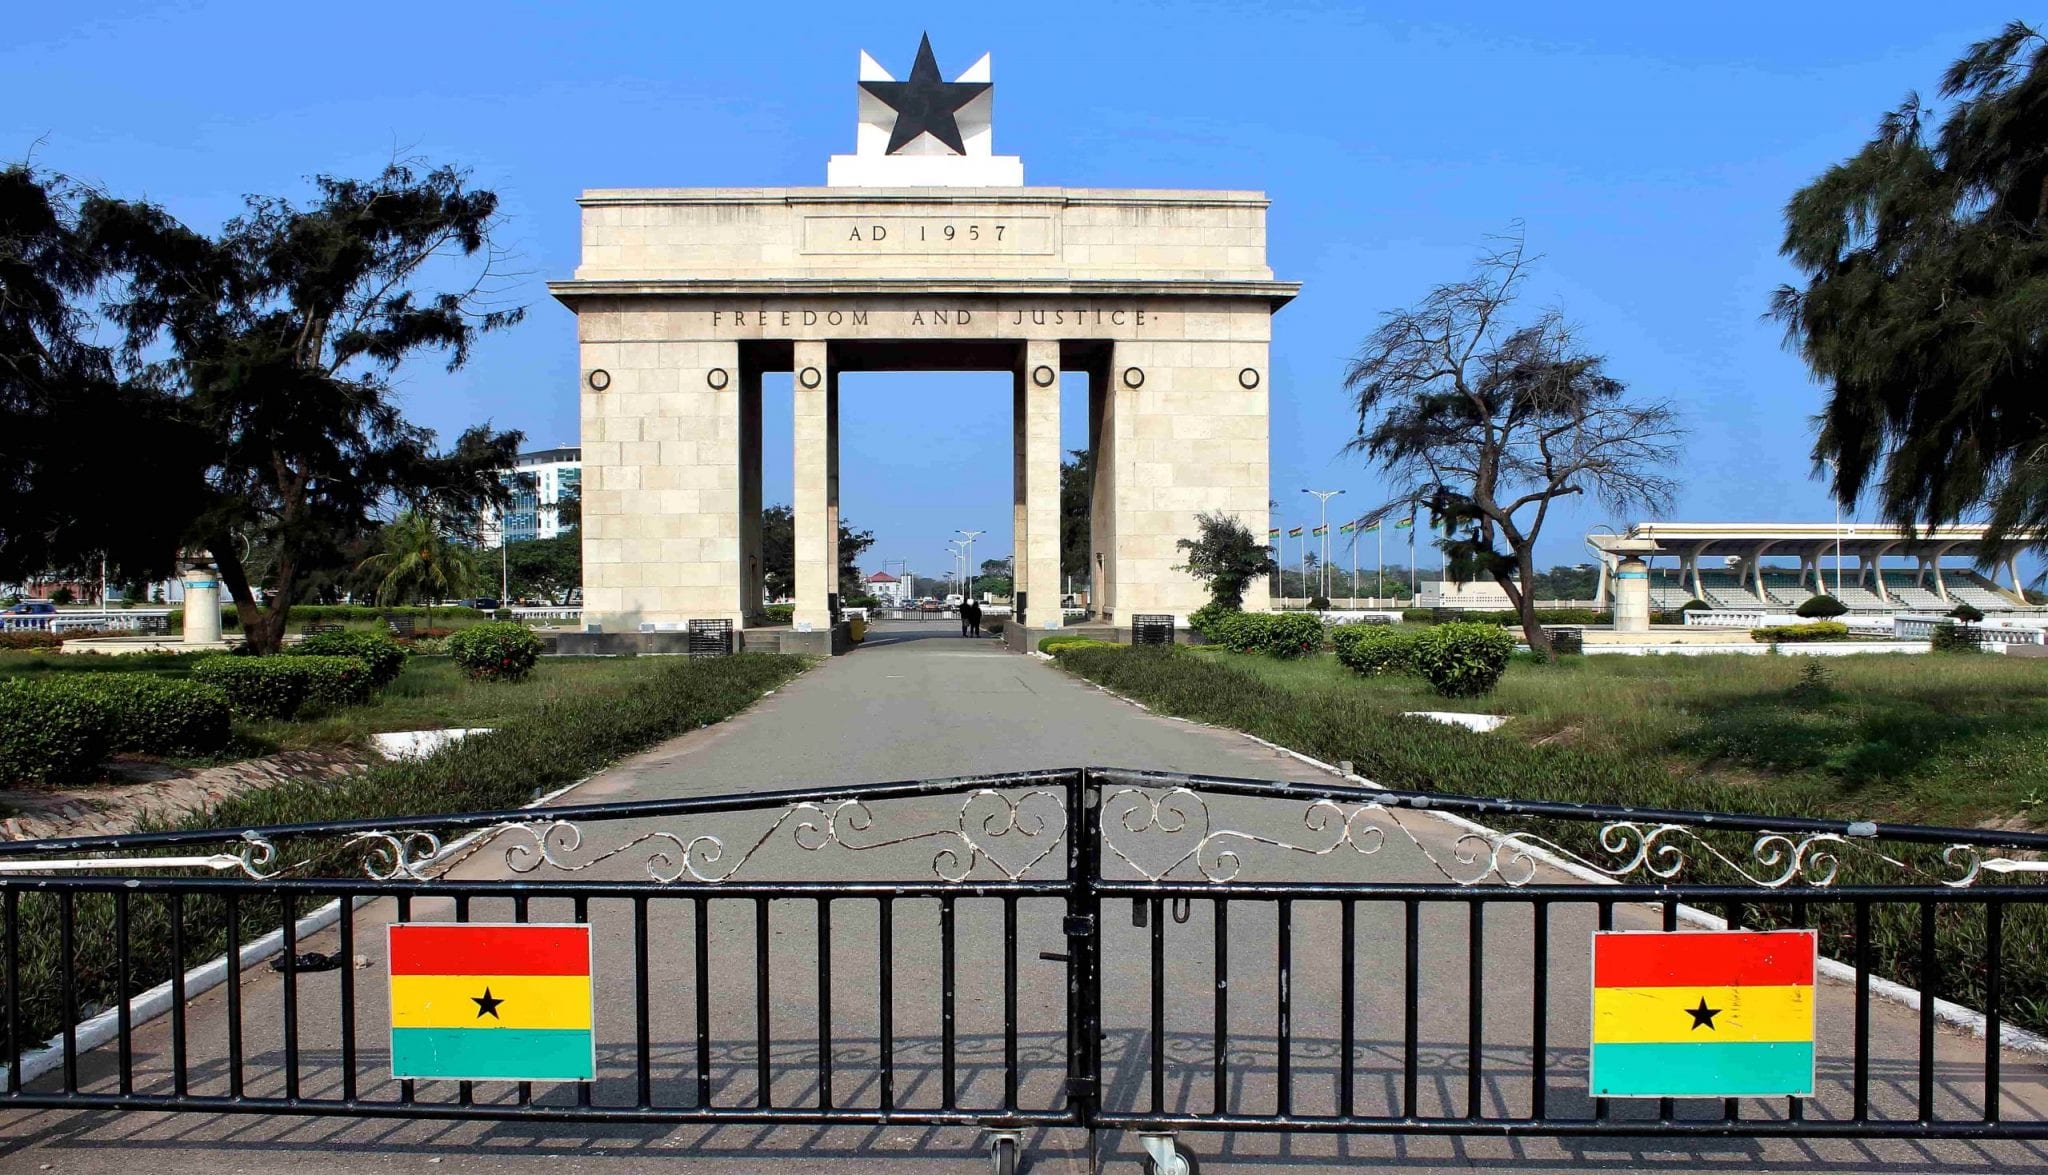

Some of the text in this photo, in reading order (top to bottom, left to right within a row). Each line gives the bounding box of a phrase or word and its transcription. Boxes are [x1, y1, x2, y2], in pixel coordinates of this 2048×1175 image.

[849, 225, 1005, 241] AD 1957
[712, 310, 869, 326] FREEDOM
[911, 309, 971, 326] AND
